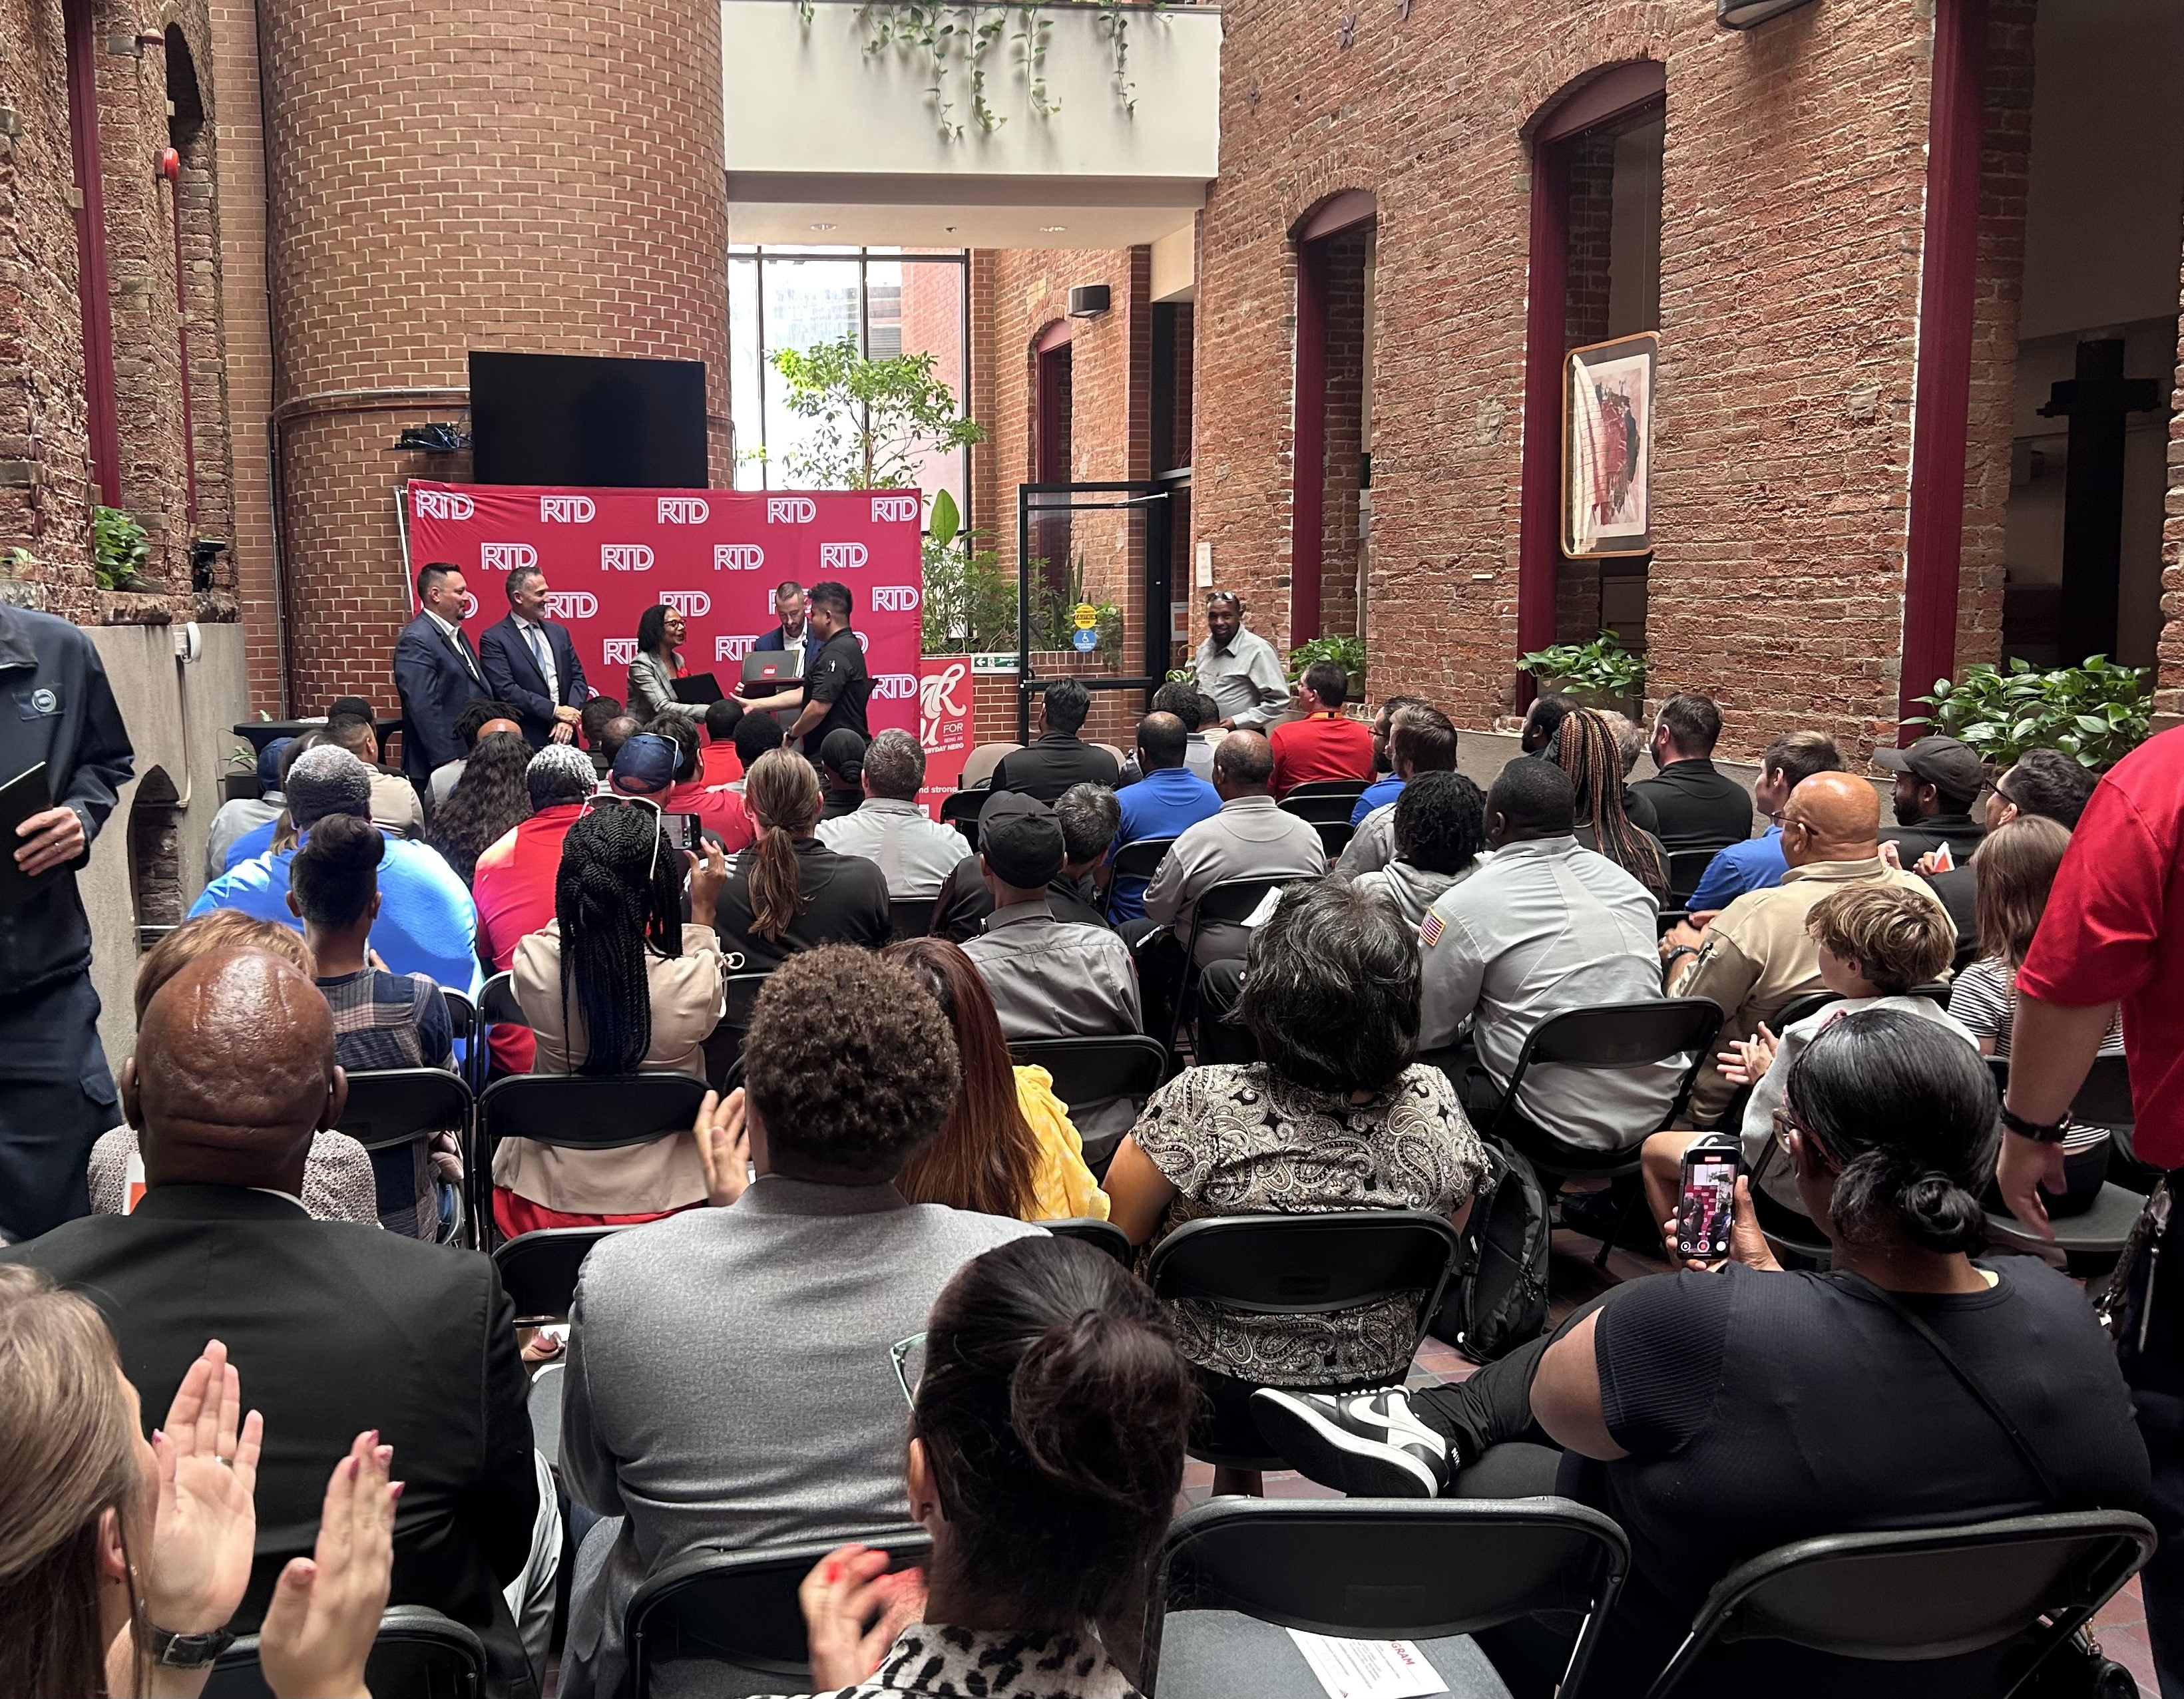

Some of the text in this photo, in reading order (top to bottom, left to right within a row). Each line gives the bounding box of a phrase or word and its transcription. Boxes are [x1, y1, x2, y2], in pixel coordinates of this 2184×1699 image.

[416, 490, 475, 520] RTD
[540, 496, 596, 524] RTD
[658, 497, 710, 524] RTD
[767, 497, 817, 524] RTD
[871, 496, 918, 522] RTD
[481, 542, 538, 570] RTD
[601, 544, 654, 571] RTD
[714, 544, 765, 570] RTD
[820, 542, 869, 568] RTD
[544, 591, 598, 618] RTD
[872, 586, 919, 612] RTD
[603, 638, 639, 665] RT
[871, 673, 919, 699] RTD
[943, 722, 964, 734] FOR
[924, 742, 965, 755] ERYDAY HERO
[919, 785, 929, 794] nd
[1391, 1640, 1416, 1665] GRAM
